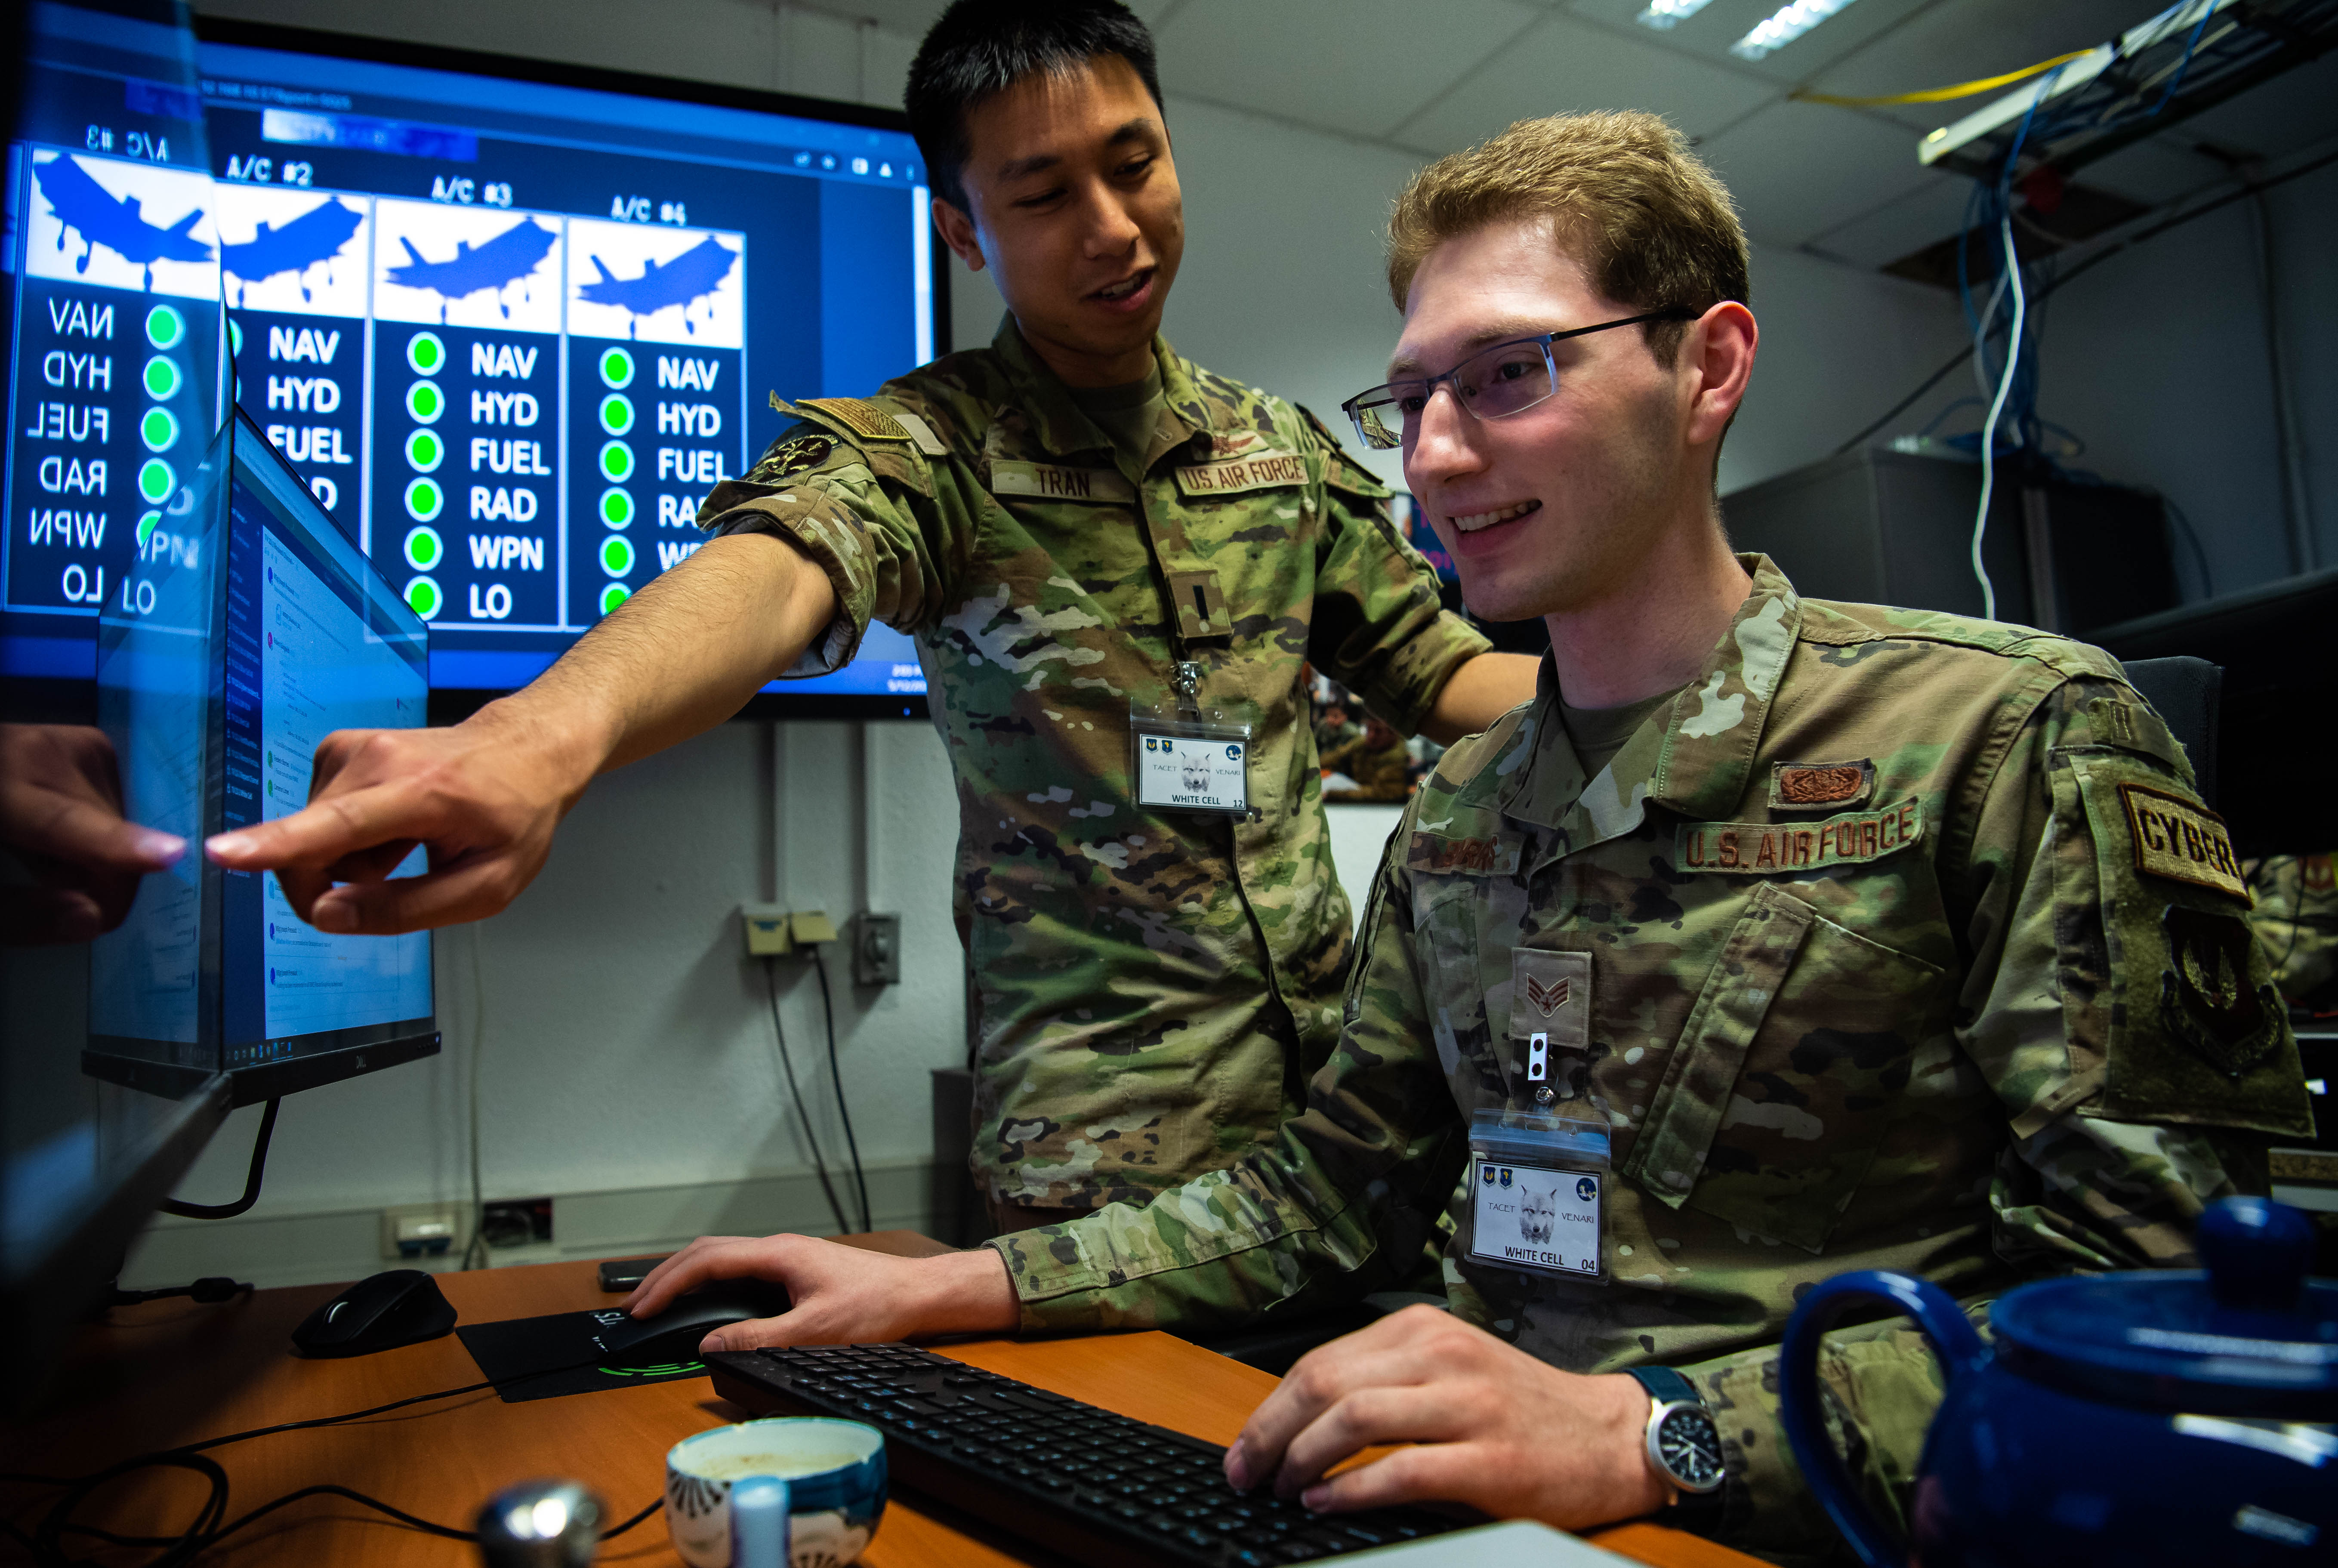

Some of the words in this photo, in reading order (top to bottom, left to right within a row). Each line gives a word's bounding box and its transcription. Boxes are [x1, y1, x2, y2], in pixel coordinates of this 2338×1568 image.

[226, 154, 272, 182] A/C
[282, 161, 312, 187] #2
[432, 175, 474, 204] A/C
[611, 194, 651, 222] A/C
[269, 326, 340, 364] NAV
[472, 343, 538, 379] NAV
[657, 355, 719, 391] NAV
[268, 375, 341, 413] HYD
[471, 390, 539, 426] HYD
[657, 402, 721, 437] HYD
[267, 425, 353, 464] FUEL
[471, 438, 551, 475] FUEL
[657, 448, 734, 482] FUEL
[1035, 467, 1090, 497] TRAN
[1218, 465, 1249, 489] AIR
[1249, 457, 1303, 483] FORCE
[470, 486, 538, 522] RAD
[469, 534, 544, 571] WPN
[469, 583, 512, 620] LO
[1172, 794, 1200, 804] WHITE
[1202, 796, 1220, 805] CELL
[1687, 831, 1749, 868] U.S.
[1756, 830, 1813, 867] AIR
[1818, 806, 1914, 860] FORCE
[2138, 808, 2240, 880] CYBER
[1488, 1202, 1515, 1213] TACET
[1561, 1213, 1594, 1223] VENARI
[1505, 1246, 1537, 1262] WHITE
[1540, 1252, 1564, 1266] CELL
[1581, 1259, 1595, 1271] 04
